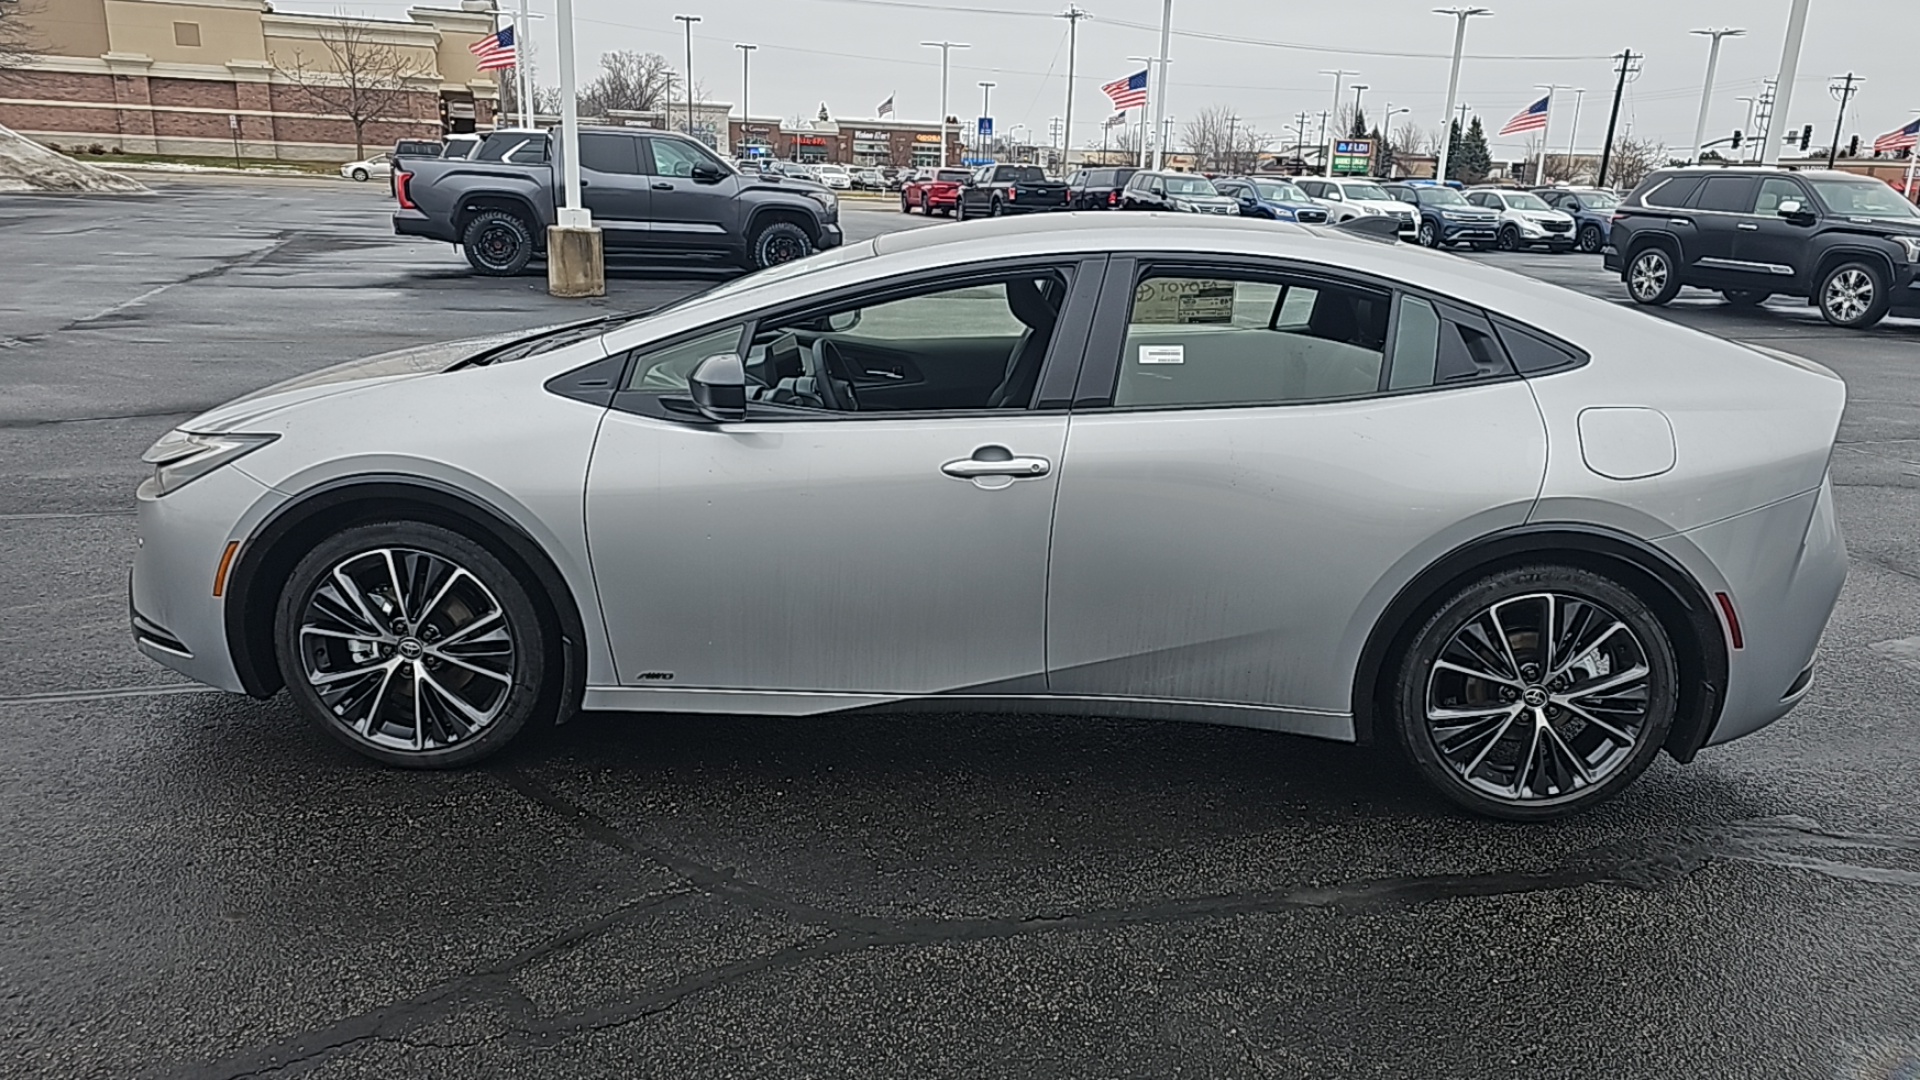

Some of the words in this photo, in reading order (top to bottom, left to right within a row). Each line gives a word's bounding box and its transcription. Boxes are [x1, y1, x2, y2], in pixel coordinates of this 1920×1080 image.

[1347, 142, 1368, 152] ALDI
[1159, 281, 1217, 293] TOYOTA
[637, 672, 674, 680] AWD
